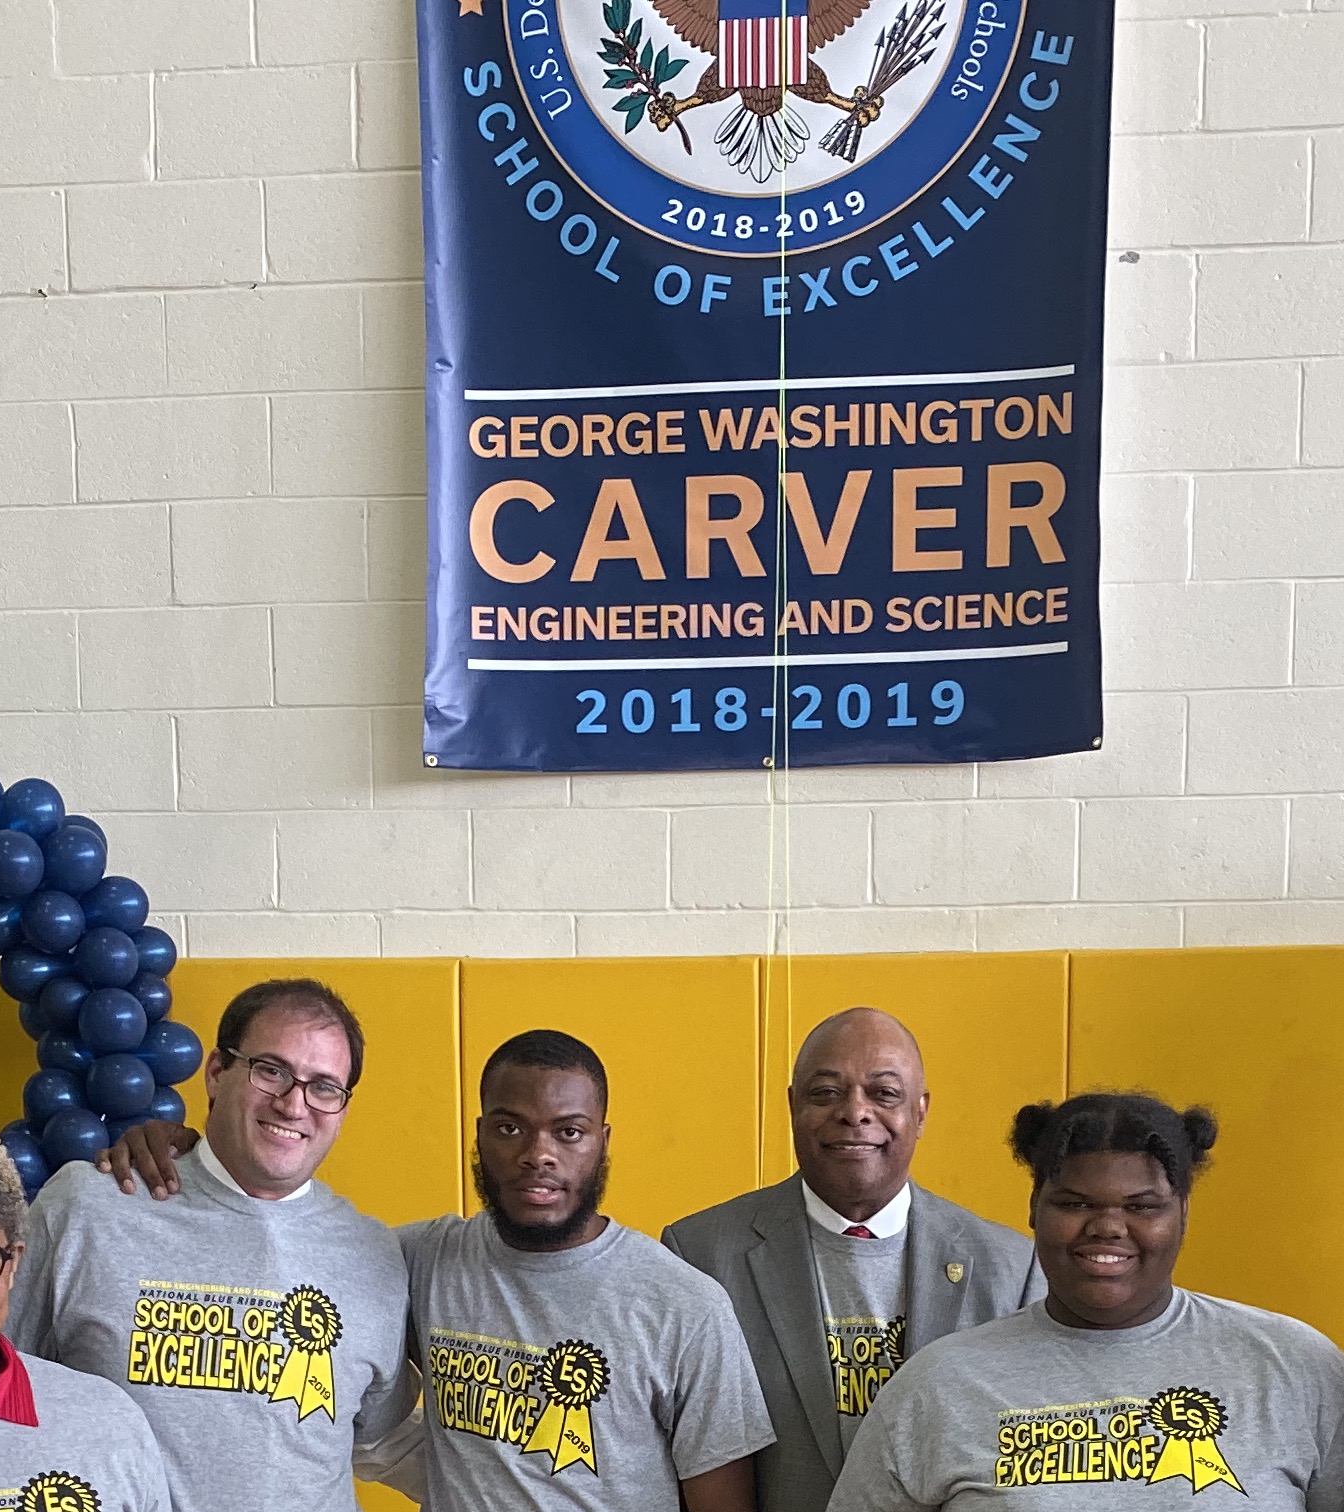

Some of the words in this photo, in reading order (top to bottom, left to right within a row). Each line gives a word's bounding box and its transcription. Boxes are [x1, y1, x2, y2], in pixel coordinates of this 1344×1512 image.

[529, 48, 572, 121] U.S.
[463, 60, 620, 284] SCHOOL
[653, 264, 733, 314] OF
[762, 29, 1075, 318] EXCELLENCE
[660, 190, 867, 240] 2018-2019
[468, 410, 686, 458] GEORGE
[699, 391, 1074, 451] WASHINGTON
[468, 461, 1068, 584] CARVER
[471, 602, 765, 642] ENGINEERING
[777, 598, 874, 636] AND
[885, 586, 1069, 633] SCIENCE
[574, 679, 966, 736] 2018-2019
[134, 1298, 239, 1337] SCHOOL
[243, 1307, 278, 1340] OF
[138, 1289, 199, 1302] NATIONAL
[203, 1294, 234, 1304] BLUE
[236, 1296, 280, 1310] RIBBON
[299, 1300, 325, 1339] ES
[128, 1330, 284, 1394] EXCELLENCE
[430, 1335, 474, 1350] NATIONAL
[475, 1343, 501, 1355] BLUE
[852, 1334, 885, 1366] OF
[307, 1375, 331, 1401] 2019
[429, 1345, 502, 1385] SCHOOL
[506, 1359, 537, 1391] OF
[559, 1355, 587, 1393] ES
[998, 1418, 1105, 1455] SCHOOL
[1109, 1410, 1145, 1440] OF
[999, 1412, 1060, 1427] NATIONAL
[1065, 1409, 1094, 1418] BLUE
[1170, 1399, 1205, 1429] ES
[564, 1429, 591, 1455] 2019
[995, 1435, 1158, 1487] EXCELLENCE
[1194, 1456, 1228, 1477] 2019
